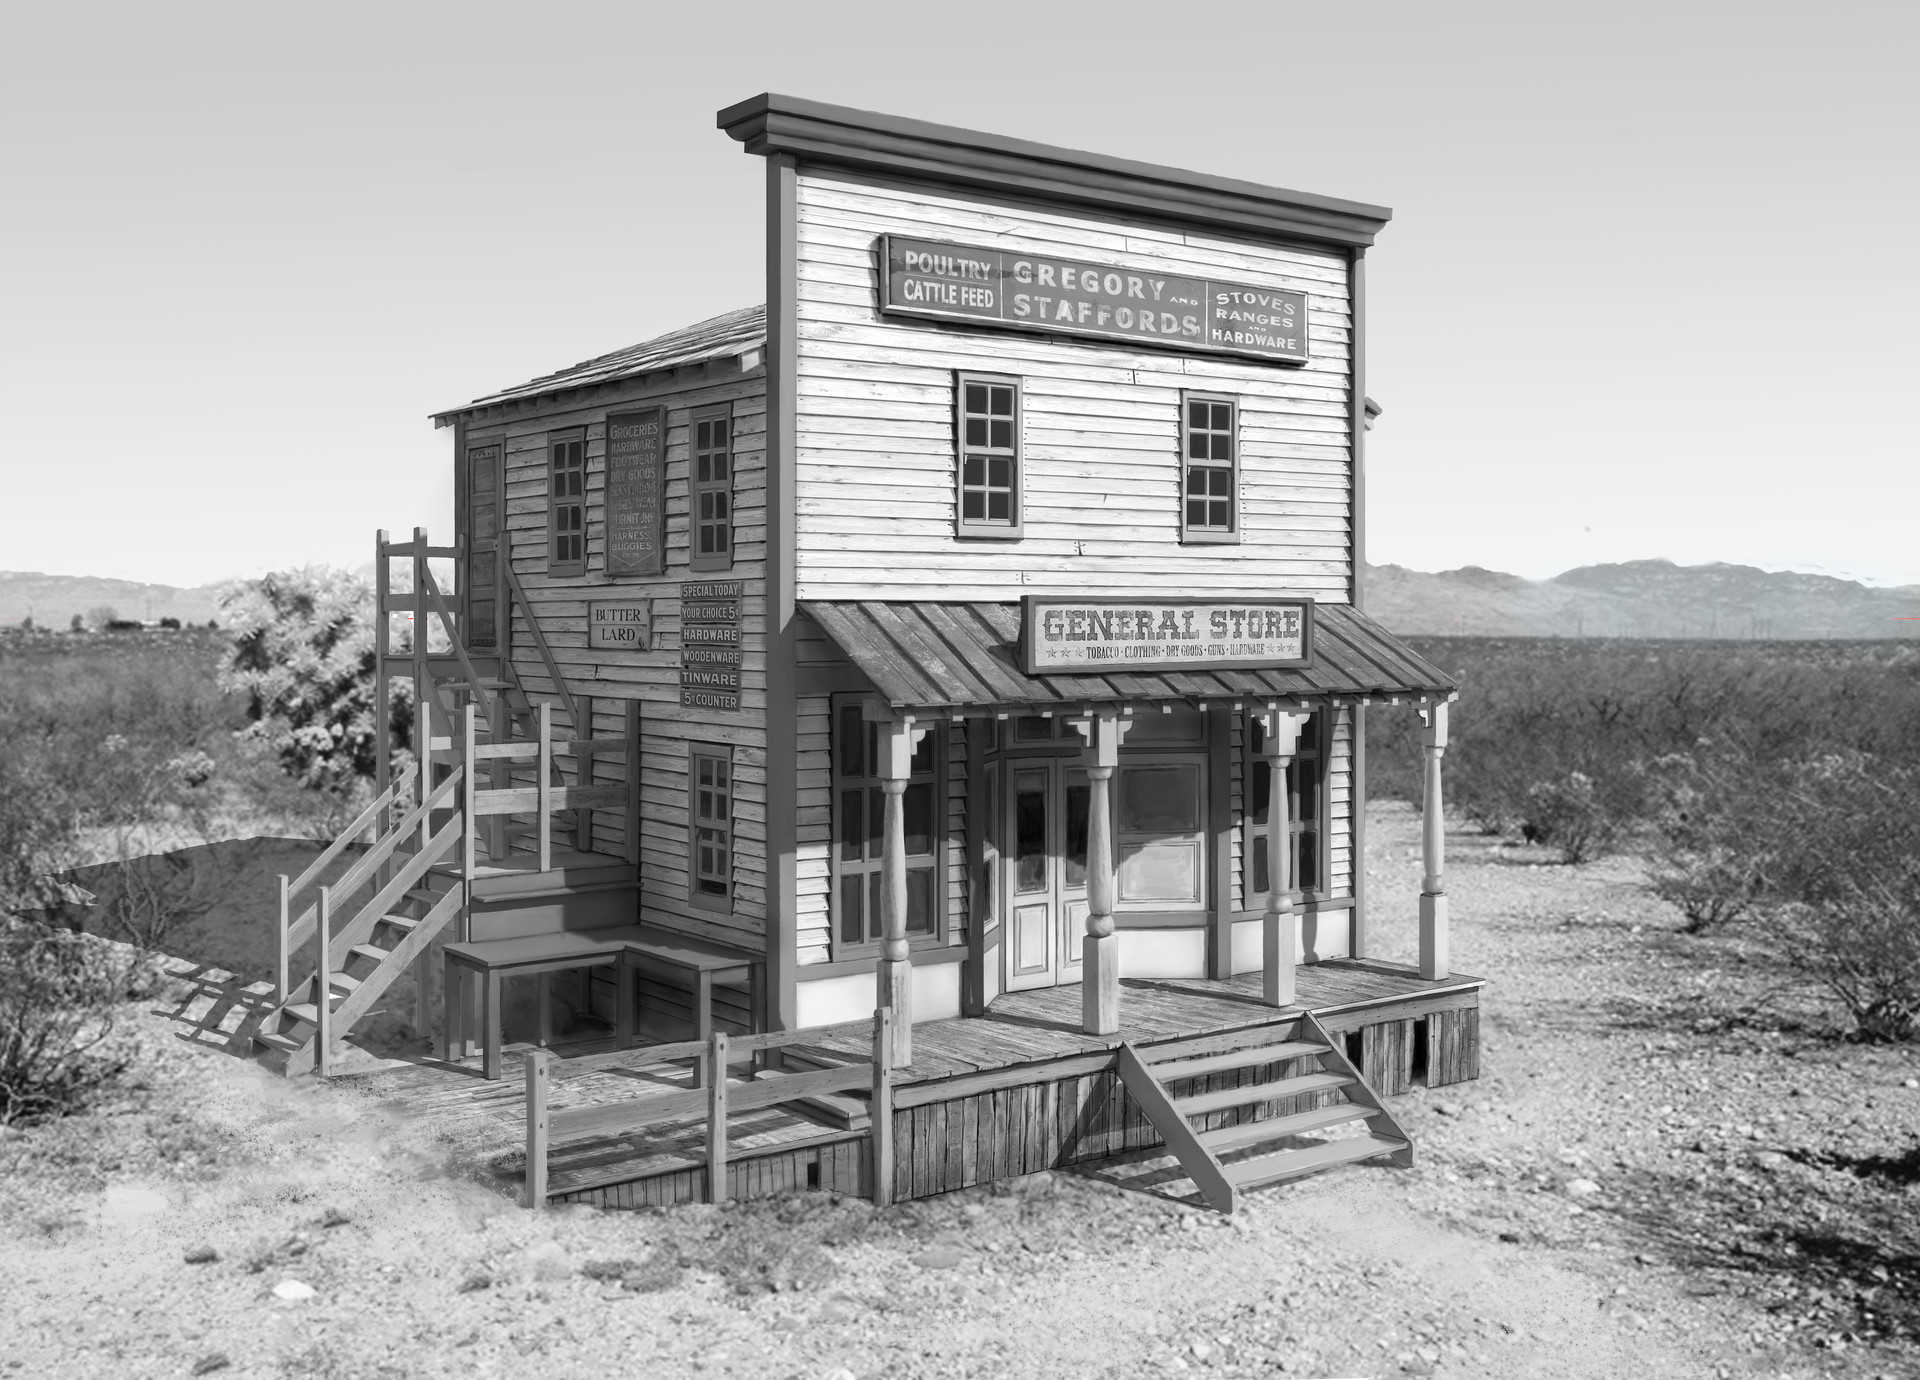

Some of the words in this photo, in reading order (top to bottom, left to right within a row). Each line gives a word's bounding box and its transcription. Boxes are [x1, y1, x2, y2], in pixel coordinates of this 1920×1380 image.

[905, 249, 992, 280] POULTRY
[1013, 261, 1166, 302] GREGORY
[1170, 296, 1198, 306] AND
[904, 278, 960, 305] CATTLE
[962, 284, 994, 309] FEED
[1216, 292, 1296, 310] STOVES
[1013, 294, 1200, 337] STAFFORDS
[1216, 308, 1294, 328] RANGES
[1212, 328, 1296, 350] HARDWARE
[610, 422, 658, 440] GROCERIES
[611, 438, 657, 454] HARDWARE
[611, 453, 657, 468] FOOTWEAR
[611, 470, 626, 482] DRY
[628, 467, 656, 481] GOODS
[612, 542, 653, 551] BUGGIES
[683, 585, 713, 598] SPECIAL
[714, 583, 739, 596] TODAY
[596, 608, 641, 621] BUTTER
[682, 607, 700, 619] YOUR
[702, 607, 727, 619] CHOICE
[1043, 610, 1200, 641] GENERAL
[1209, 609, 1299, 640] STORE
[602, 628, 636, 641] LARD
[684, 629, 737, 641] HARDWARE
[684, 651, 739, 664] WOODENWARE
[1086, 646, 1119, 660] TOBACCO
[1124, 645, 1161, 659] CLOTHING
[1166, 645, 1180, 657] DRY
[1181, 644, 1203, 657] GOODS
[1208, 644, 1226, 656] GUNS
[1230, 643, 1265, 656] HARDWARE
[682, 672, 737, 686] TINWARE
[696, 693, 737, 708] COUNTER
